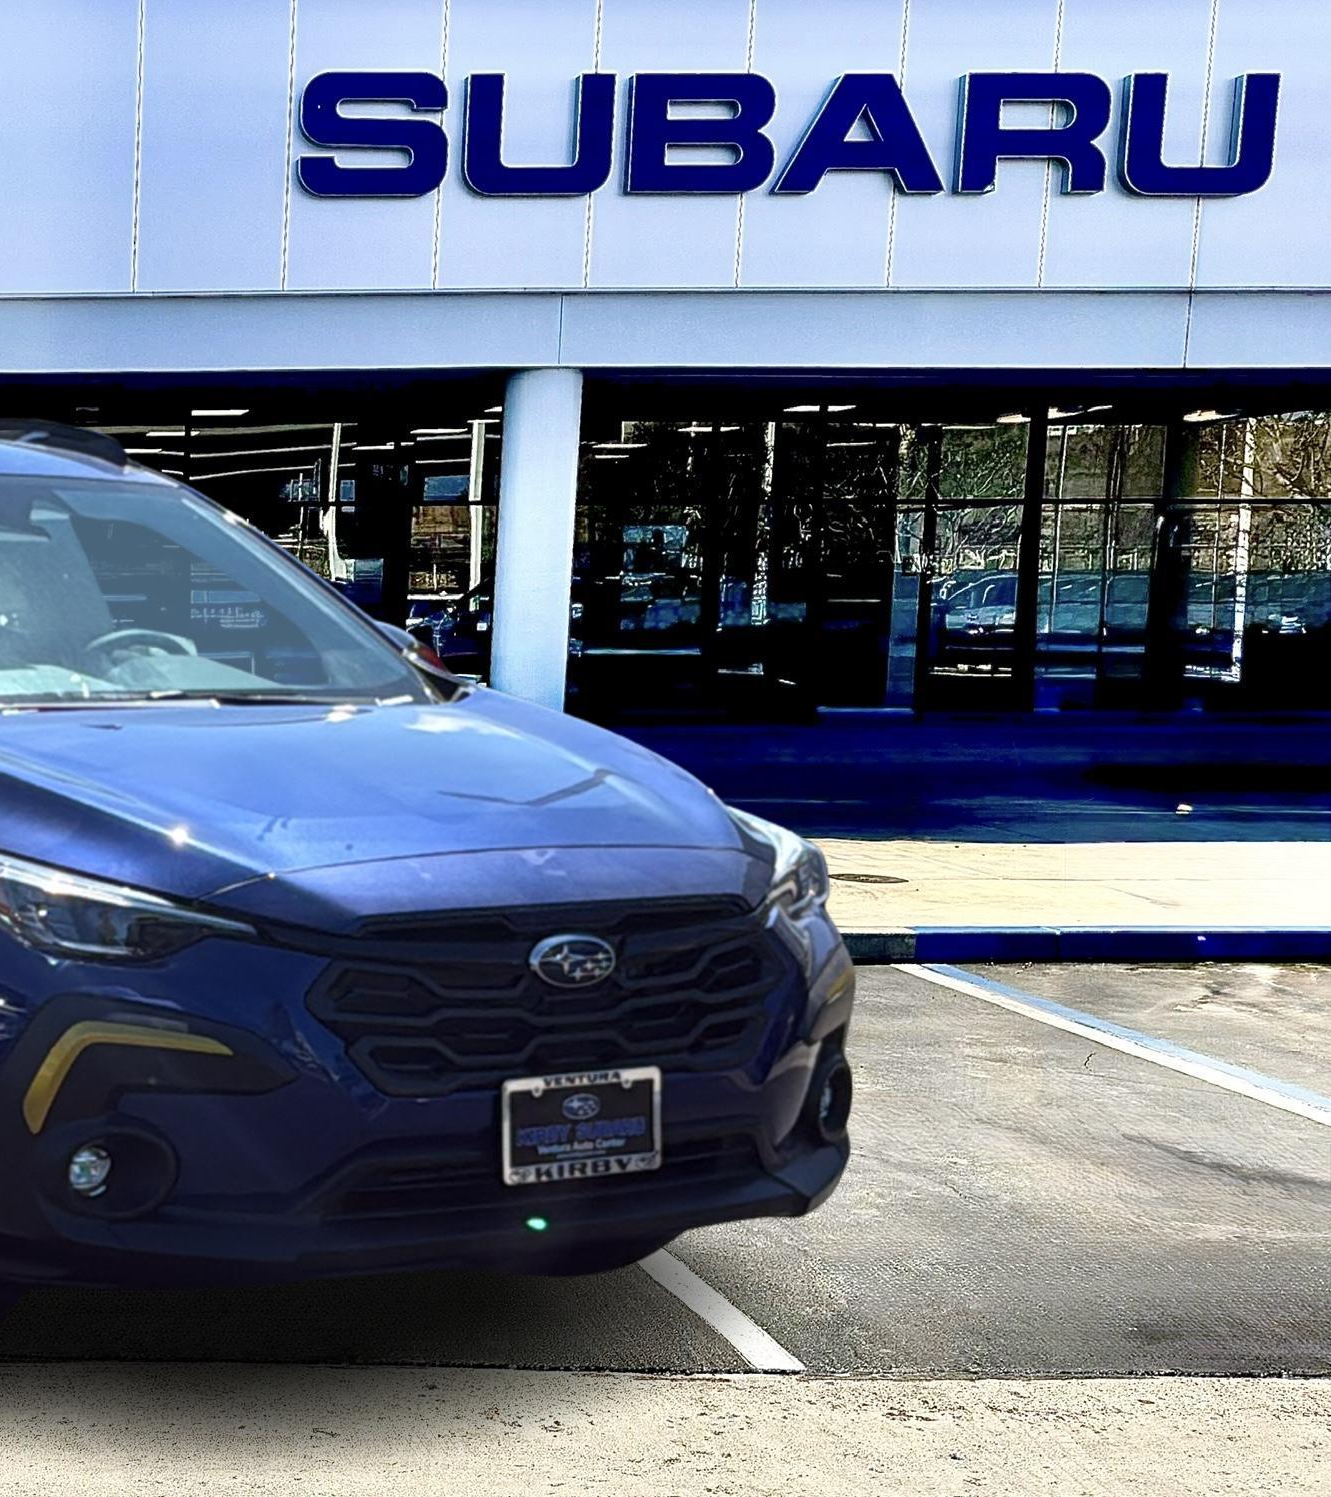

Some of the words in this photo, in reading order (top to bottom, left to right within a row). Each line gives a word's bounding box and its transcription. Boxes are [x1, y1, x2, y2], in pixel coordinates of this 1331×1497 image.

[296, 70, 1282, 198] SUBARU
[543, 1071, 622, 1088] VENTURA
[573, 1140, 594, 1150] Auto
[595, 1137, 627, 1148] Center
[534, 1157, 632, 1181] KIRBY
